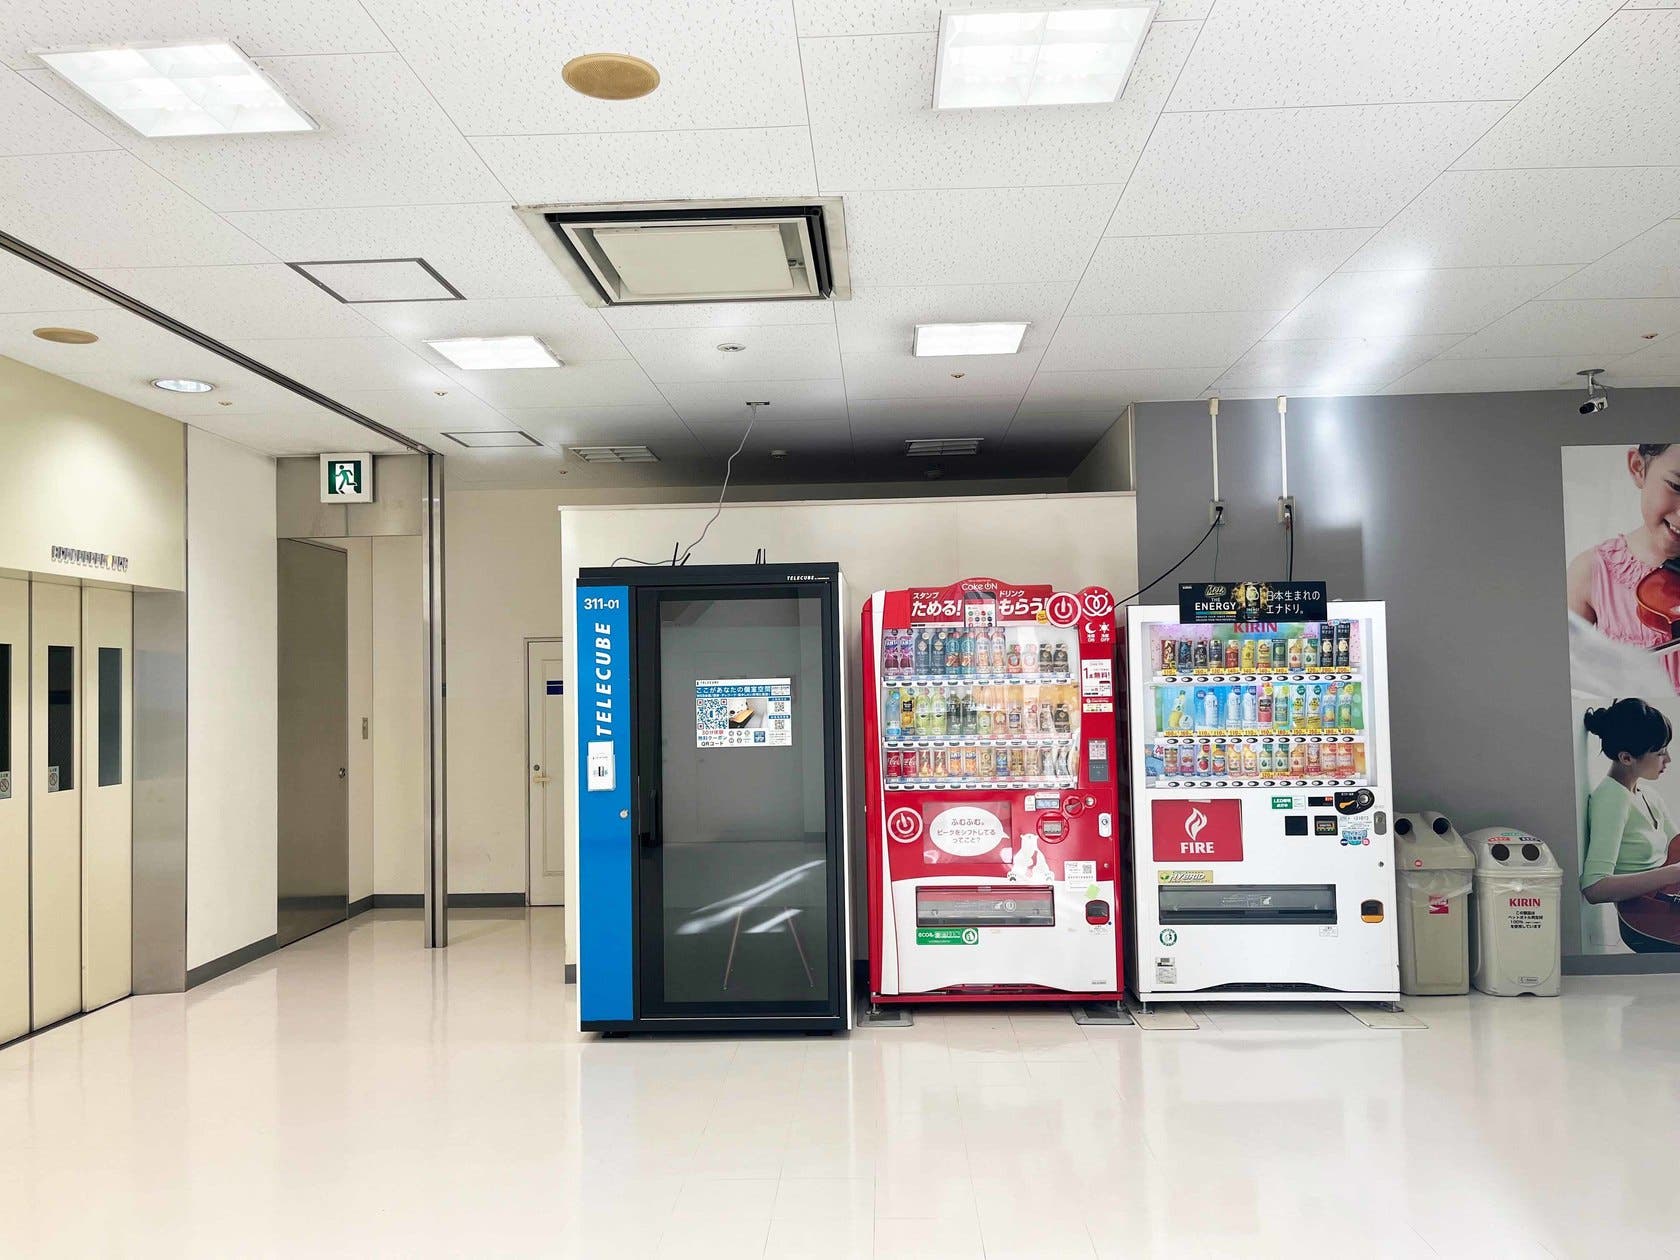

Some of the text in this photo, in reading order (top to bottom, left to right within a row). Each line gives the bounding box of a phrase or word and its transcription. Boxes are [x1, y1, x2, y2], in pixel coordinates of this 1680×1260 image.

[961, 582, 984, 591] Coke
[912, 591, 939, 599] スタンプ
[999, 590, 1025, 598] ドリンク
[1266, 590, 1321, 601] 日本生まれの
[584, 598, 620, 610] 311-01
[911, 599, 962, 617] ためる!
[1195, 602, 1237, 611] ENERGY
[1233, 622, 1278, 634] KIRIN
[595, 622, 612, 736] TELECUBE
[1180, 841, 1215, 854] FIRE
[1509, 898, 1541, 907] KIRIN
